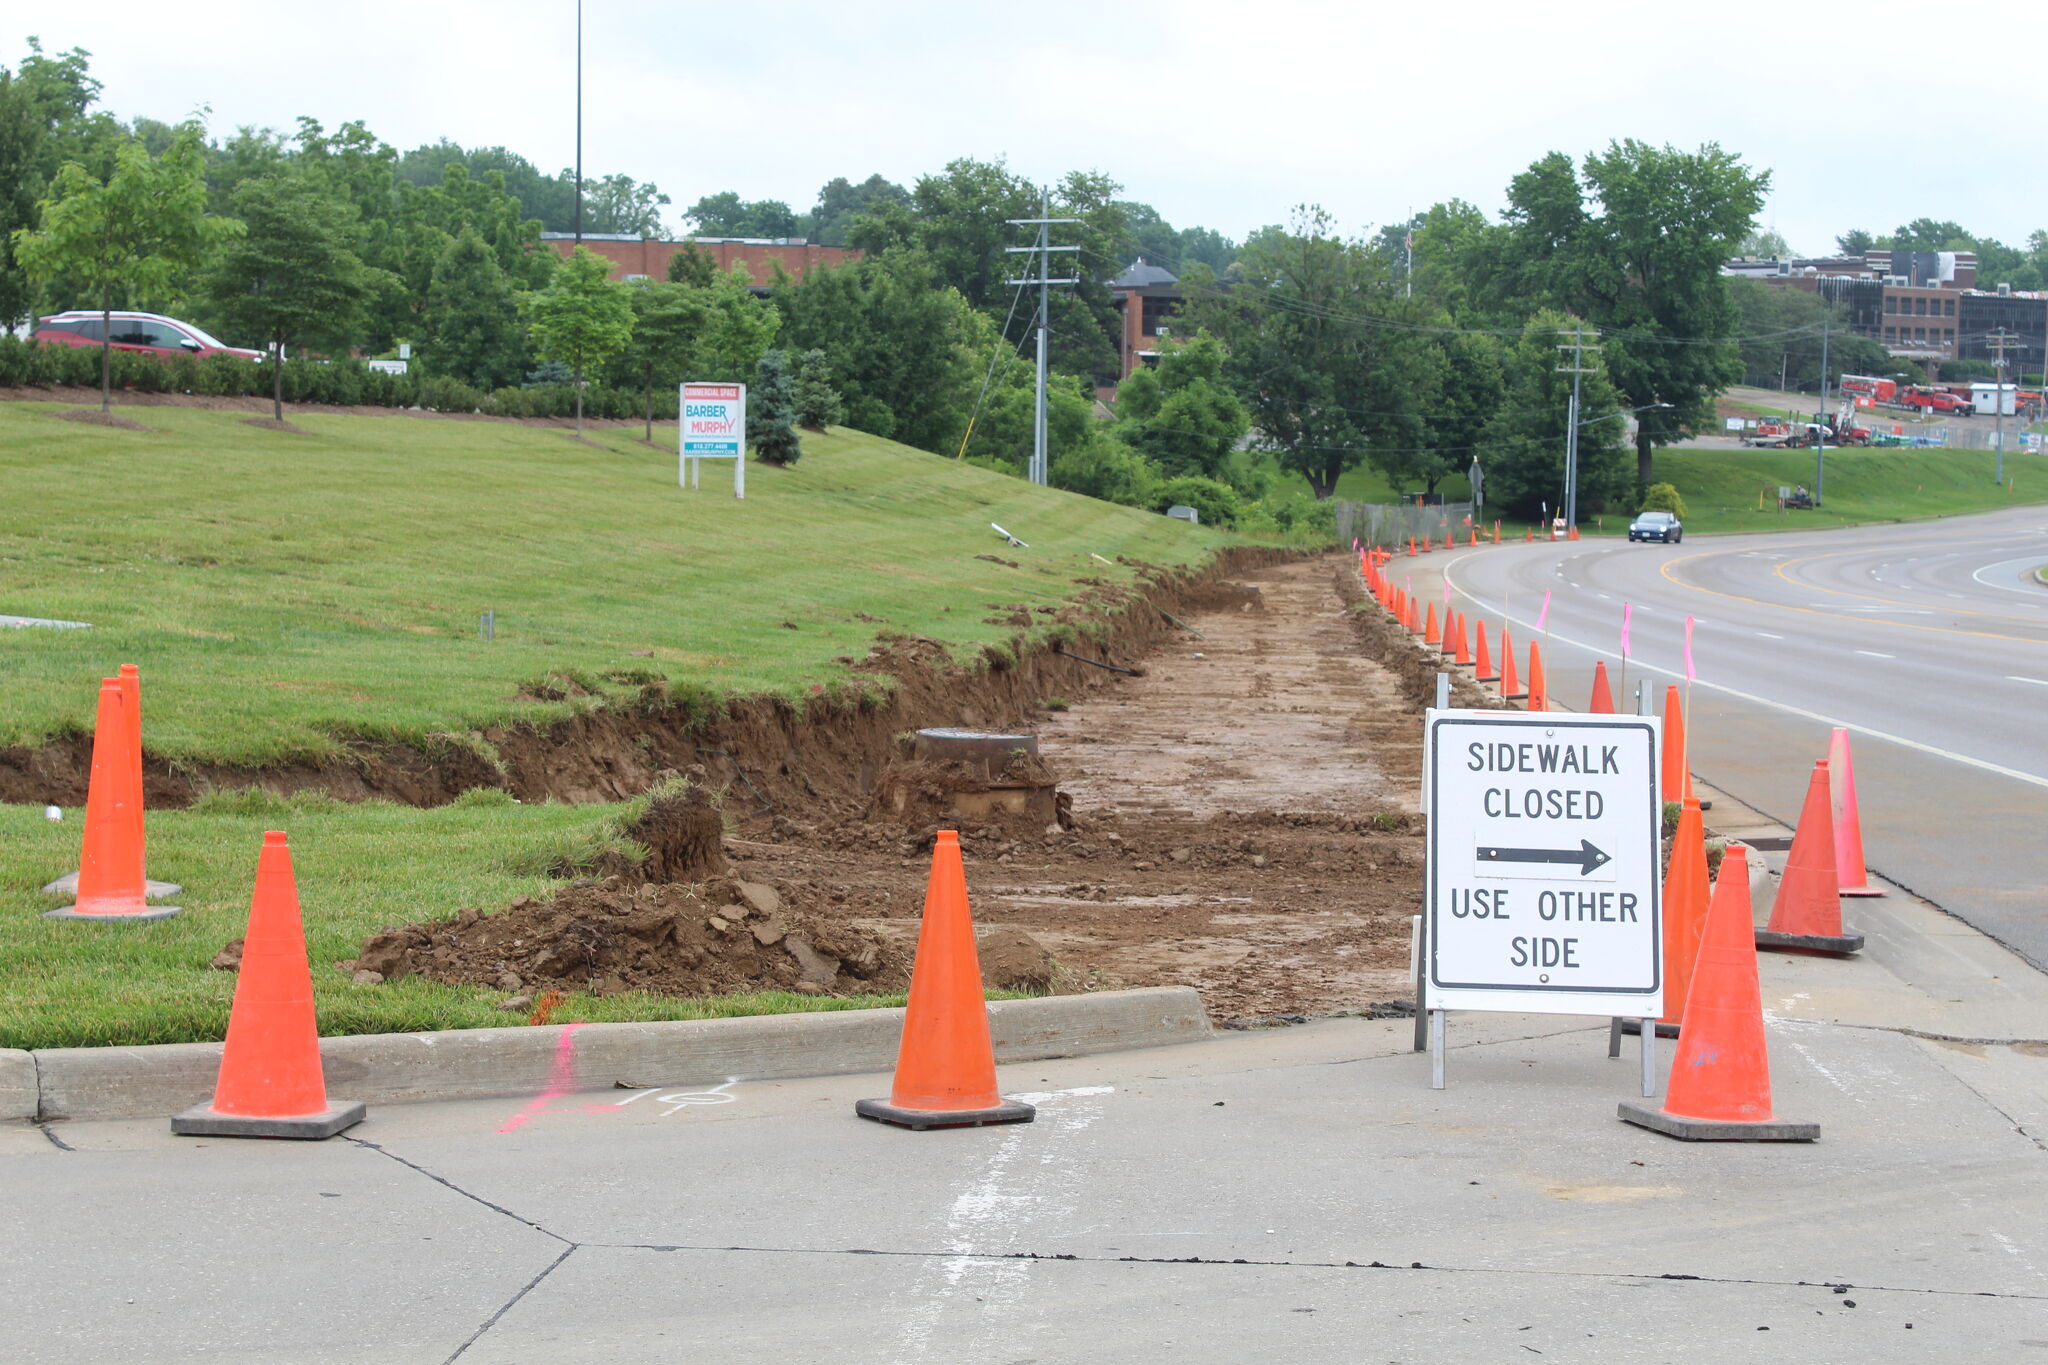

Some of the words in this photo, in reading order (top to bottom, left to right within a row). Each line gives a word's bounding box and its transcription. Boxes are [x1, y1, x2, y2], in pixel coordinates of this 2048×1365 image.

[720, 388, 736, 397] SPACE
[686, 405, 726, 417] BARBER
[692, 418, 735, 433] MURPHY
[1467, 742, 1619, 775] SIDEWALK
[1484, 788, 1603, 820] CLOSED
[1452, 888, 1510, 919] USE
[1538, 891, 1638, 923] OTHER
[1510, 936, 1579, 968] SIDE
